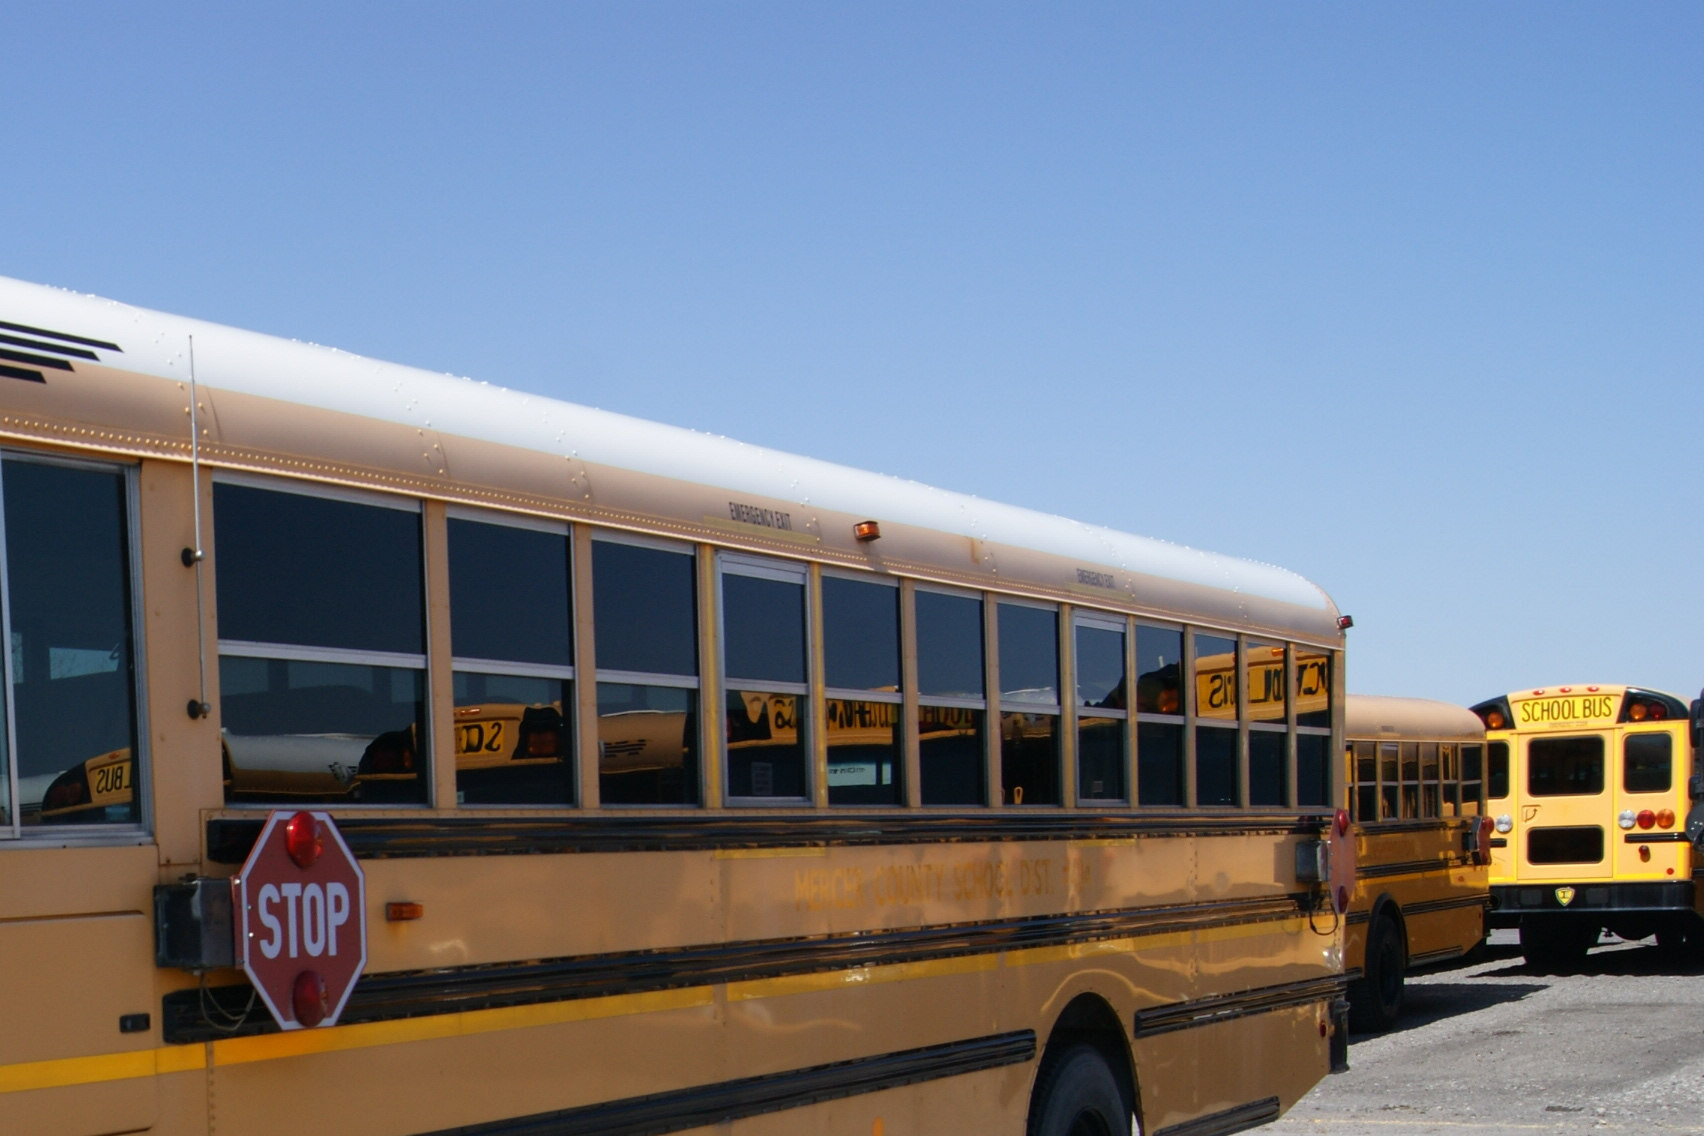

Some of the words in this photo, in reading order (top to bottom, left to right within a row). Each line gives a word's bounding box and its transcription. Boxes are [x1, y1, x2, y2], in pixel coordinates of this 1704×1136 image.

[729, 502, 774, 528] EMERGENCY
[775, 511, 792, 531] EXIT
[1522, 700, 1579, 722] SCHOOL
[1583, 697, 1612, 718] BUS
[874, 863, 944, 906] COUNTY
[954, 861, 1013, 900] SCHOOL
[258, 881, 350, 960] STOP
